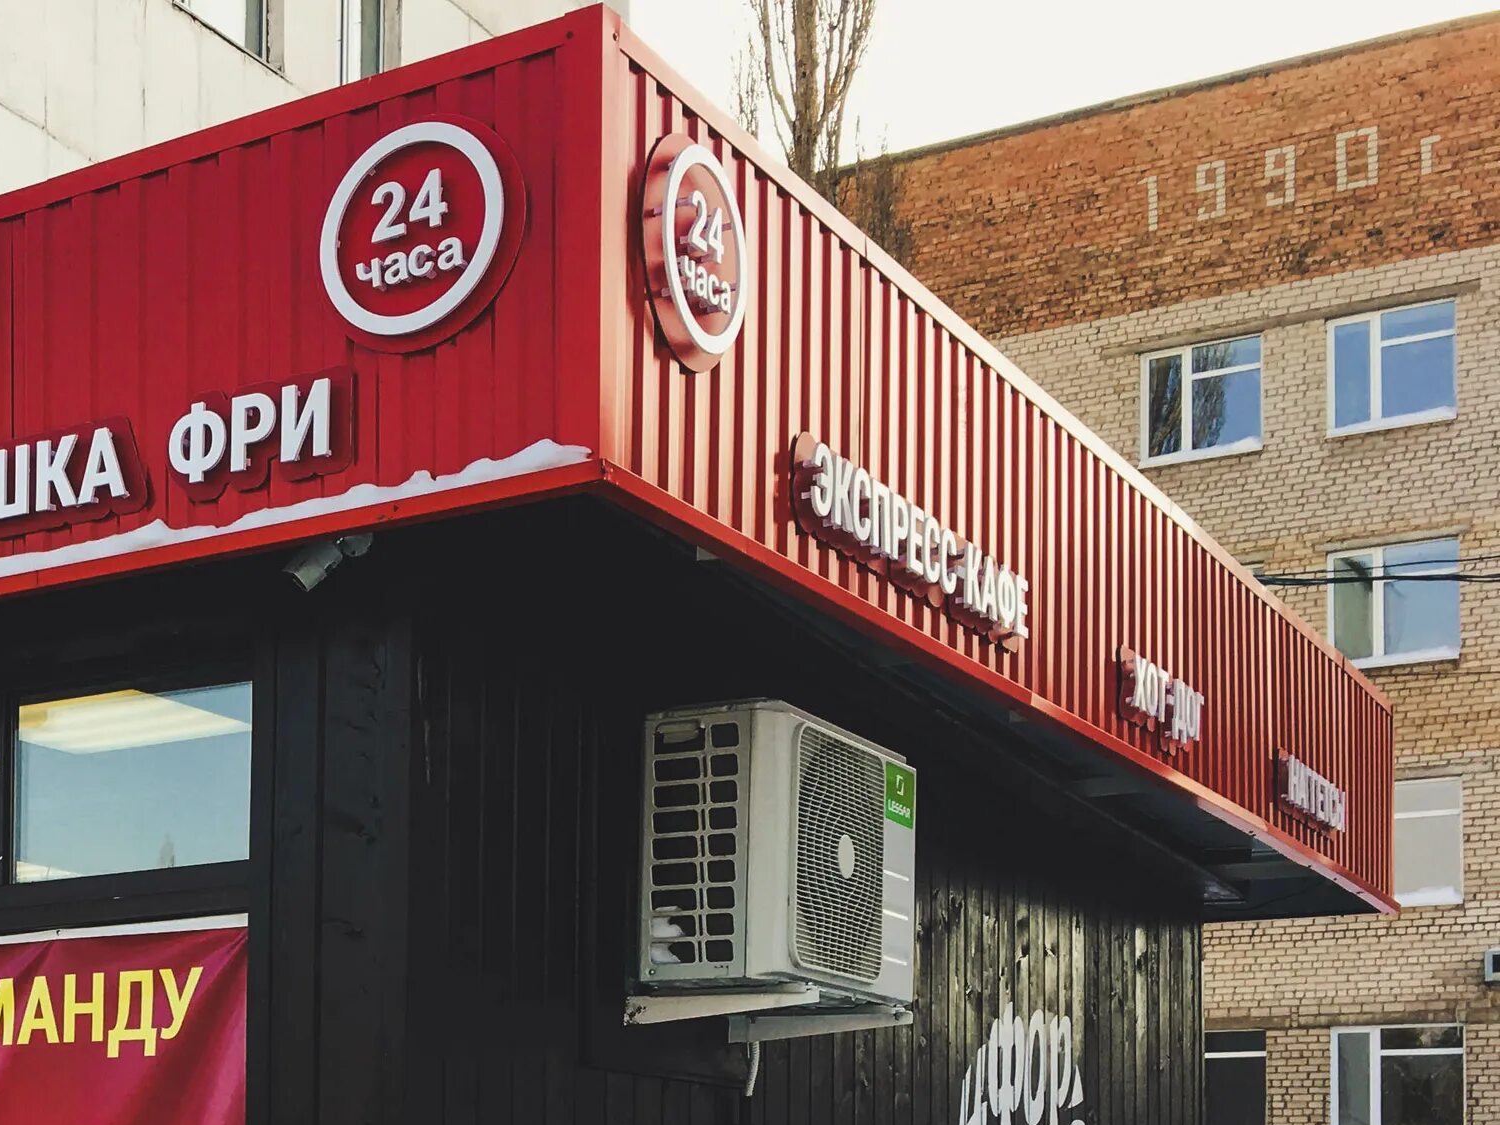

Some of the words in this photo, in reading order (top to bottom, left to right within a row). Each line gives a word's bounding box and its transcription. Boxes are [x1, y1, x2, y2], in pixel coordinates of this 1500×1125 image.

[371, 168, 448, 243] 24
[689, 190, 725, 264] 24
[356, 235, 464, 289] часа
[681, 254, 731, 314] часа
[168, 377, 331, 483] ФРИ
[810, 442, 1029, 639] ЭКСПРЕСС-КАФЕ
[1133, 654, 1204, 744] ХОТ-ДОГ
